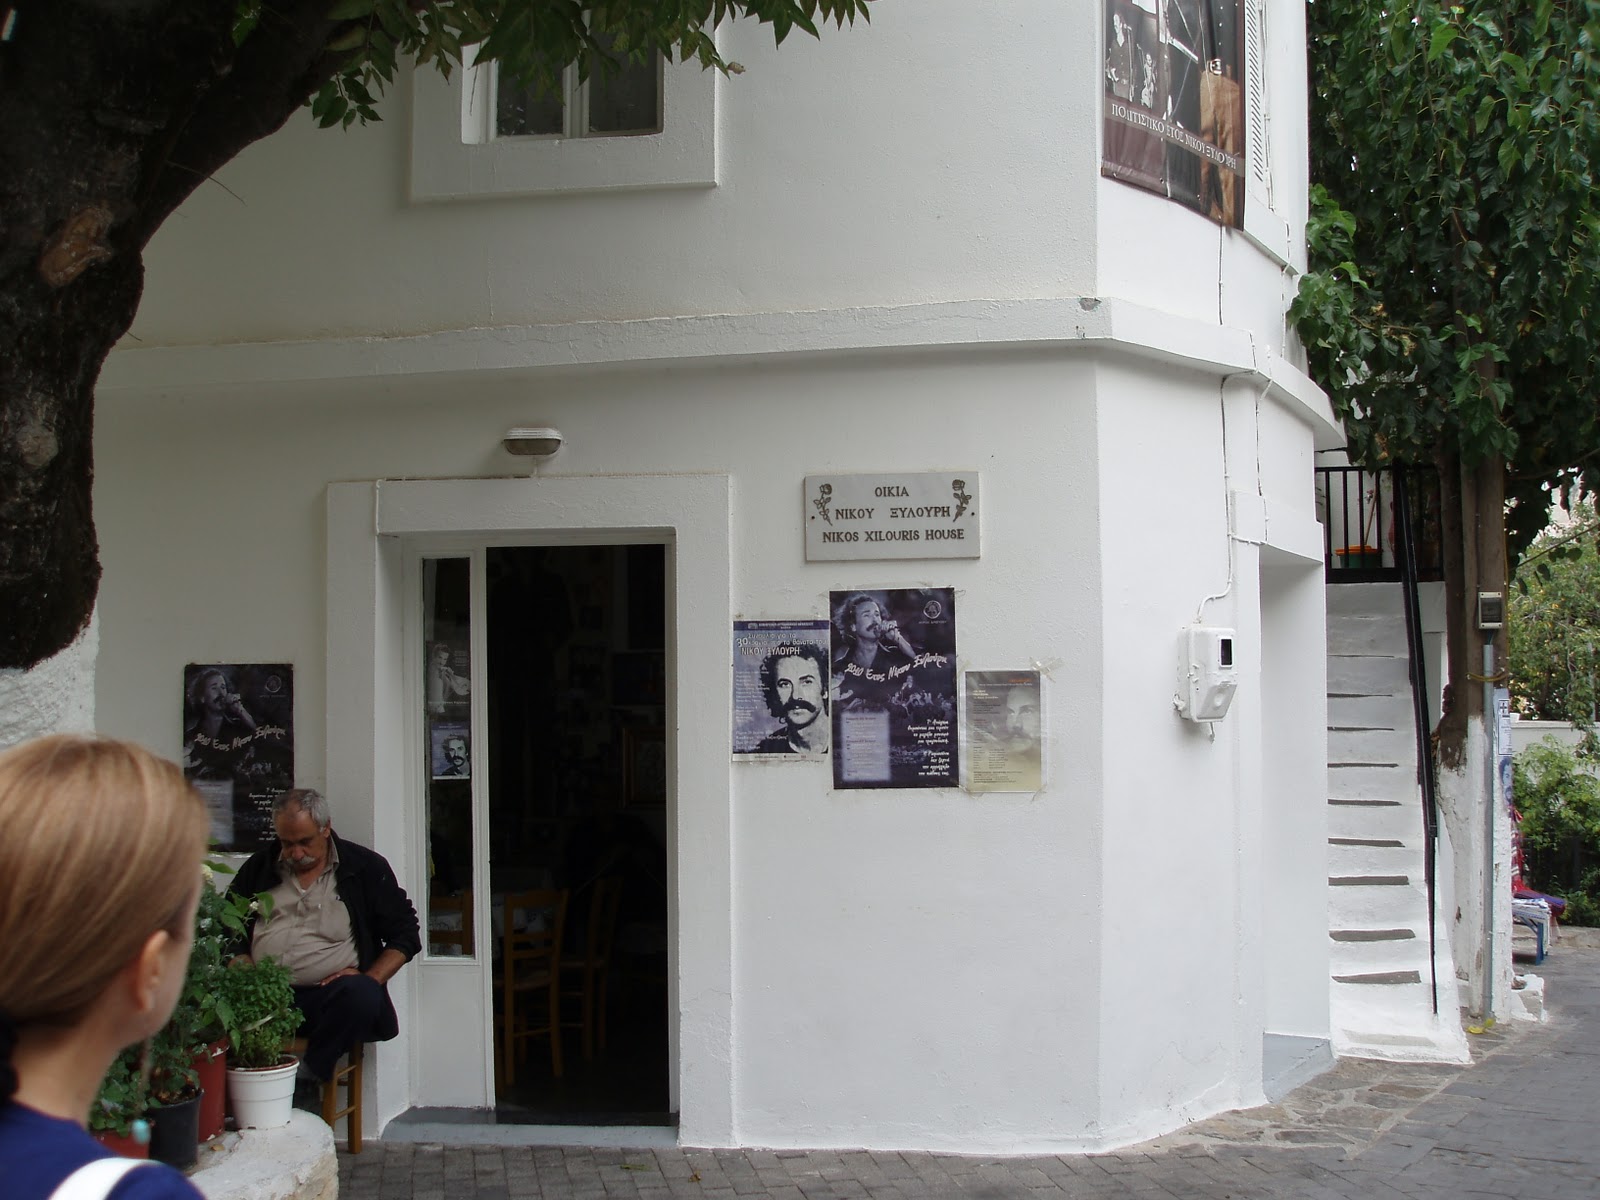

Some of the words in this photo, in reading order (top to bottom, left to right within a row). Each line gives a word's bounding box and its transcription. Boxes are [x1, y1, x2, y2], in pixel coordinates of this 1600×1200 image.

[1165, 123, 1184, 143] ΕΤΟΣ
[1185, 131, 1206, 153] ΝΙΚΟΥ
[874, 486, 910, 498] ΟΙΚΙΑ
[835, 508, 875, 520] ΝΙΚΟΥ
[889, 506, 951, 519] ΞΥΛΟΥΡΗ
[822, 531, 860, 543] NIKOS
[864, 529, 920, 543] XILOURIS
[925, 528, 965, 541] HOUSE
[741, 646, 764, 656] ΝΙΚΟΥ
[767, 646, 800, 656] ΞΥΛΟΥΡΗ
